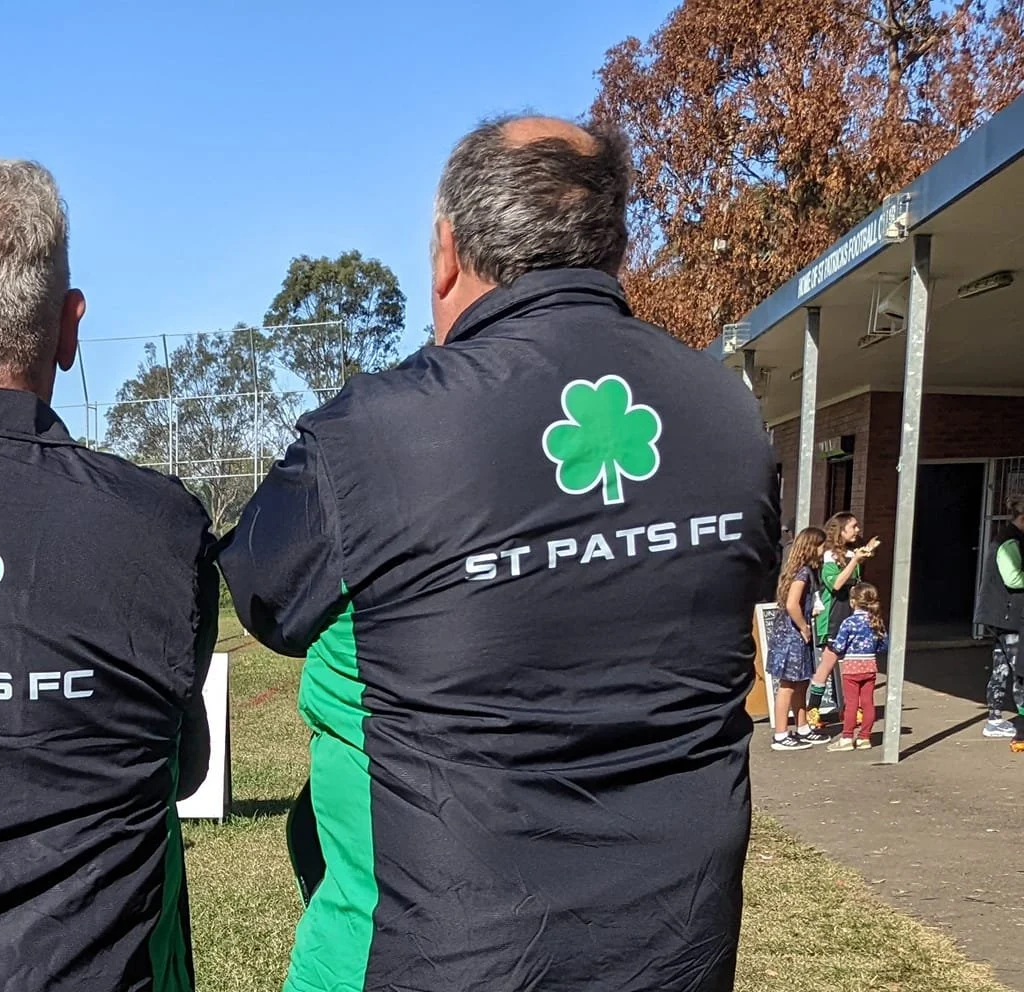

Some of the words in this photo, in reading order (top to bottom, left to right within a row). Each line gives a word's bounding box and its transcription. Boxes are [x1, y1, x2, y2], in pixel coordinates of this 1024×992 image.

[847, 219, 878, 262] FOOTBALL
[465, 546, 531, 581] ST
[547, 522, 677, 568] PATS
[690, 512, 743, 545] FC
[29, 669, 94, 700] FC
